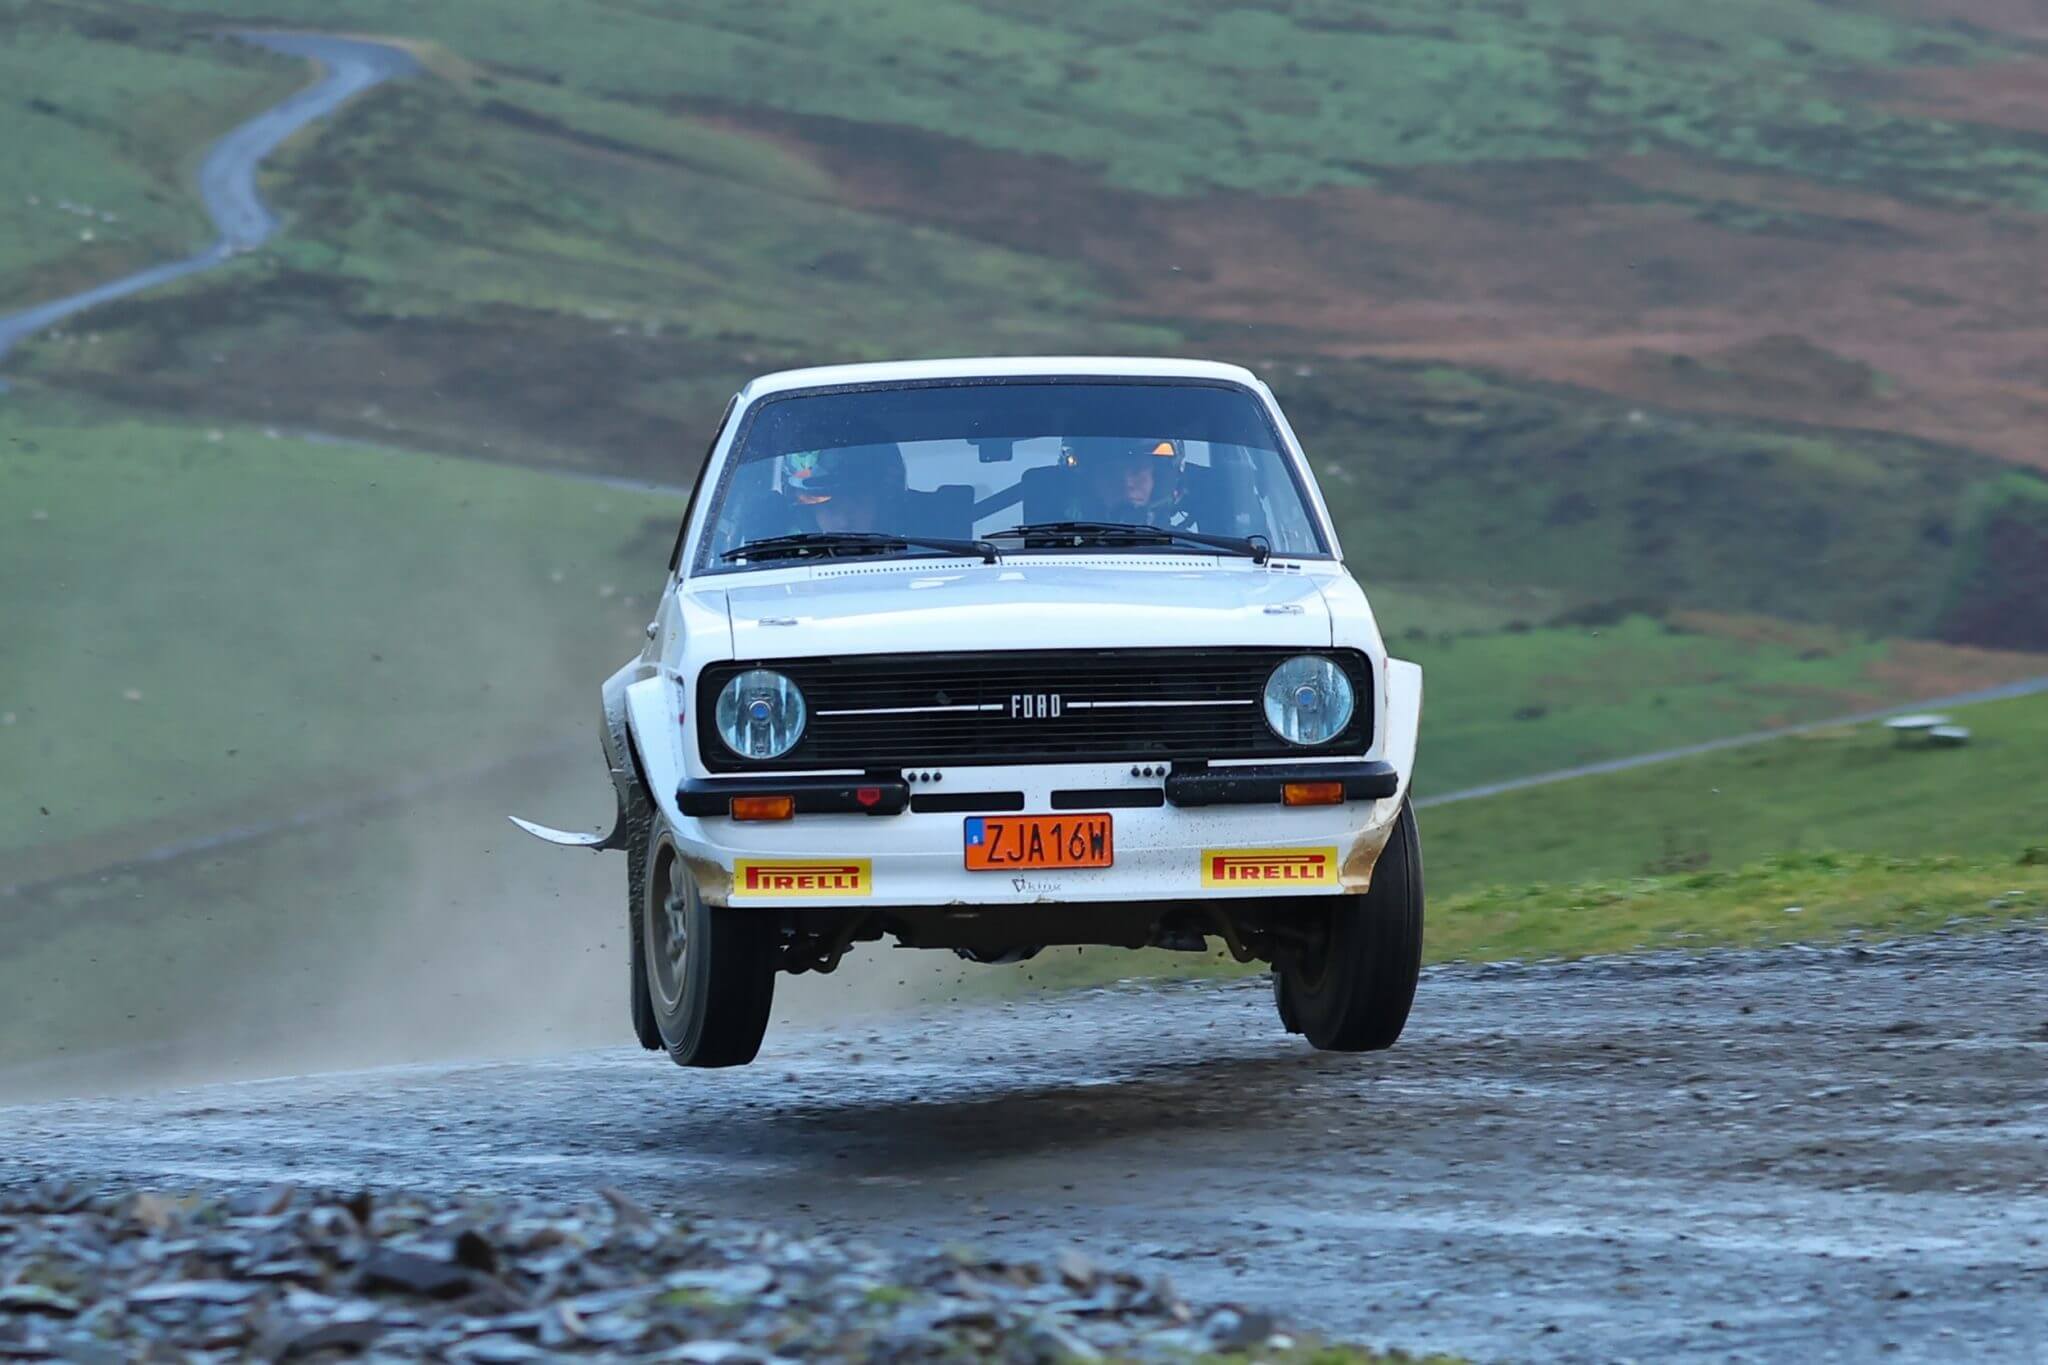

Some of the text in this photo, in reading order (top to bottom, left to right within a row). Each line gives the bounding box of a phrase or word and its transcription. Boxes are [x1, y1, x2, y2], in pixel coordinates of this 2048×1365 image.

[1011, 694, 1061, 718] FORD
[986, 821, 1106, 864] ZJA16W
[745, 866, 860, 889] PIRELLI
[1212, 855, 1326, 880] PIRELLI
